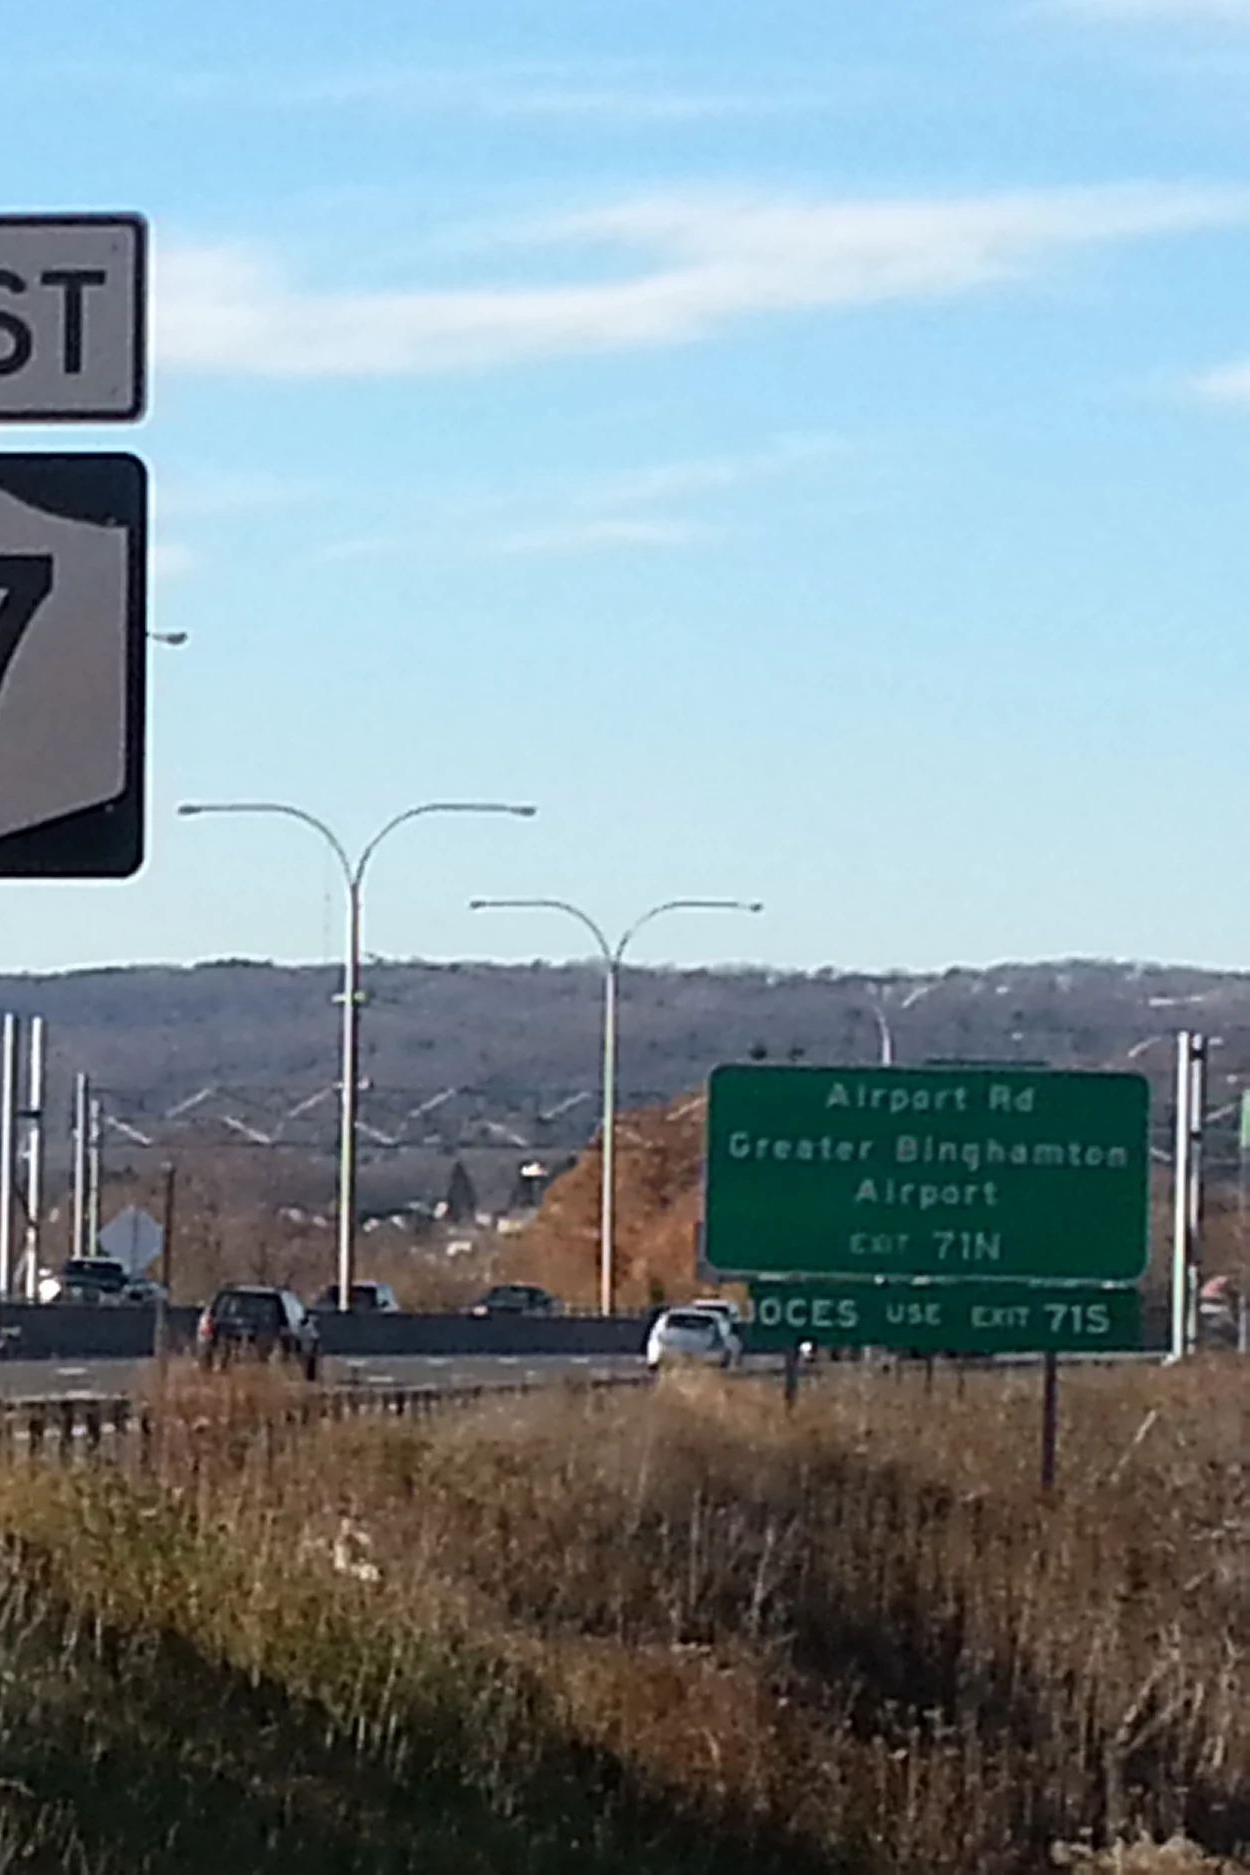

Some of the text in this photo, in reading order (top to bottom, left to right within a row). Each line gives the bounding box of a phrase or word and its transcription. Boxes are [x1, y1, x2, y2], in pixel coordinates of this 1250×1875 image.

[826, 1083, 1035, 1114] Airport Rd
[728, 1132, 1128, 1170] Greater Binghamton
[855, 1178, 999, 1209] Airport
[851, 1232, 1001, 1260] EXIT 71N
[886, 1303, 941, 1325] USE
[971, 1307, 1029, 1328] EXIT
[1044, 1304, 1111, 1334] 71S
